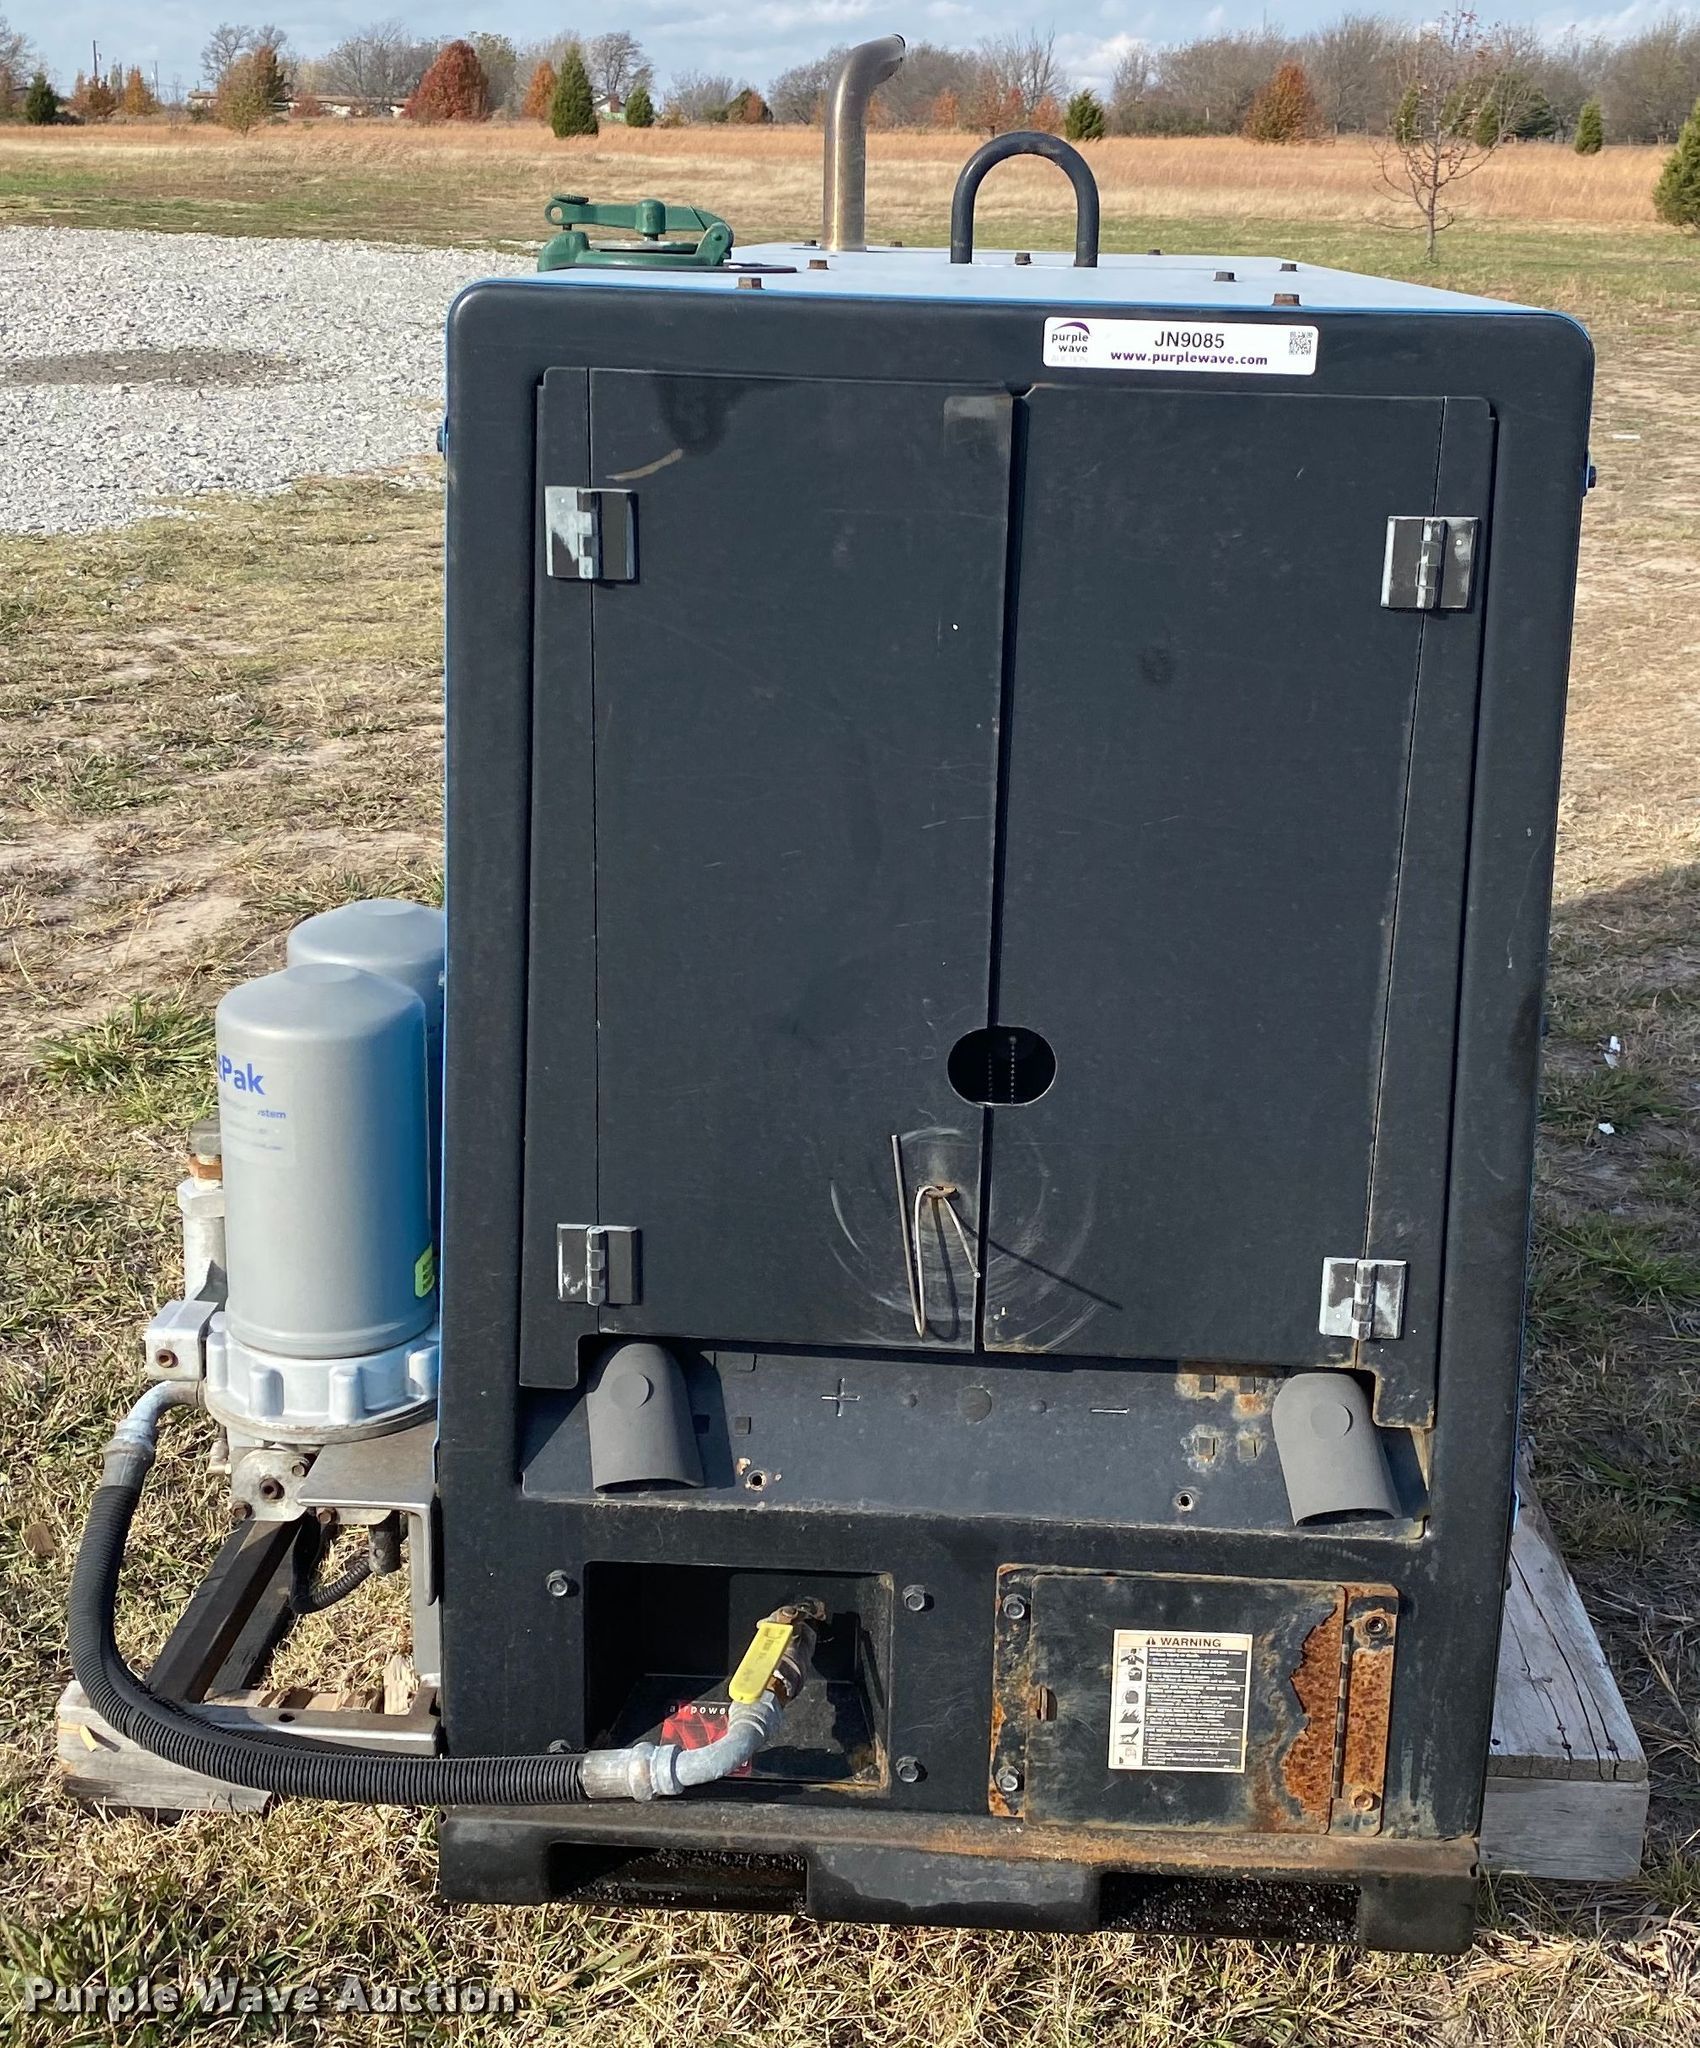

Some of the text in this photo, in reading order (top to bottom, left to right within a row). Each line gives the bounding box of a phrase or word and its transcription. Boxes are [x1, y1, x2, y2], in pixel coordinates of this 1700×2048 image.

[1051, 331, 1089, 344] purple
[1154, 331, 1225, 349] JN9085
[1058, 344, 1088, 353] wave
[1110, 351, 1268, 366] www.purplewave.com
[1159, 1637, 1222, 1648] WARNING
[669, 1705, 727, 1715] airpowe
